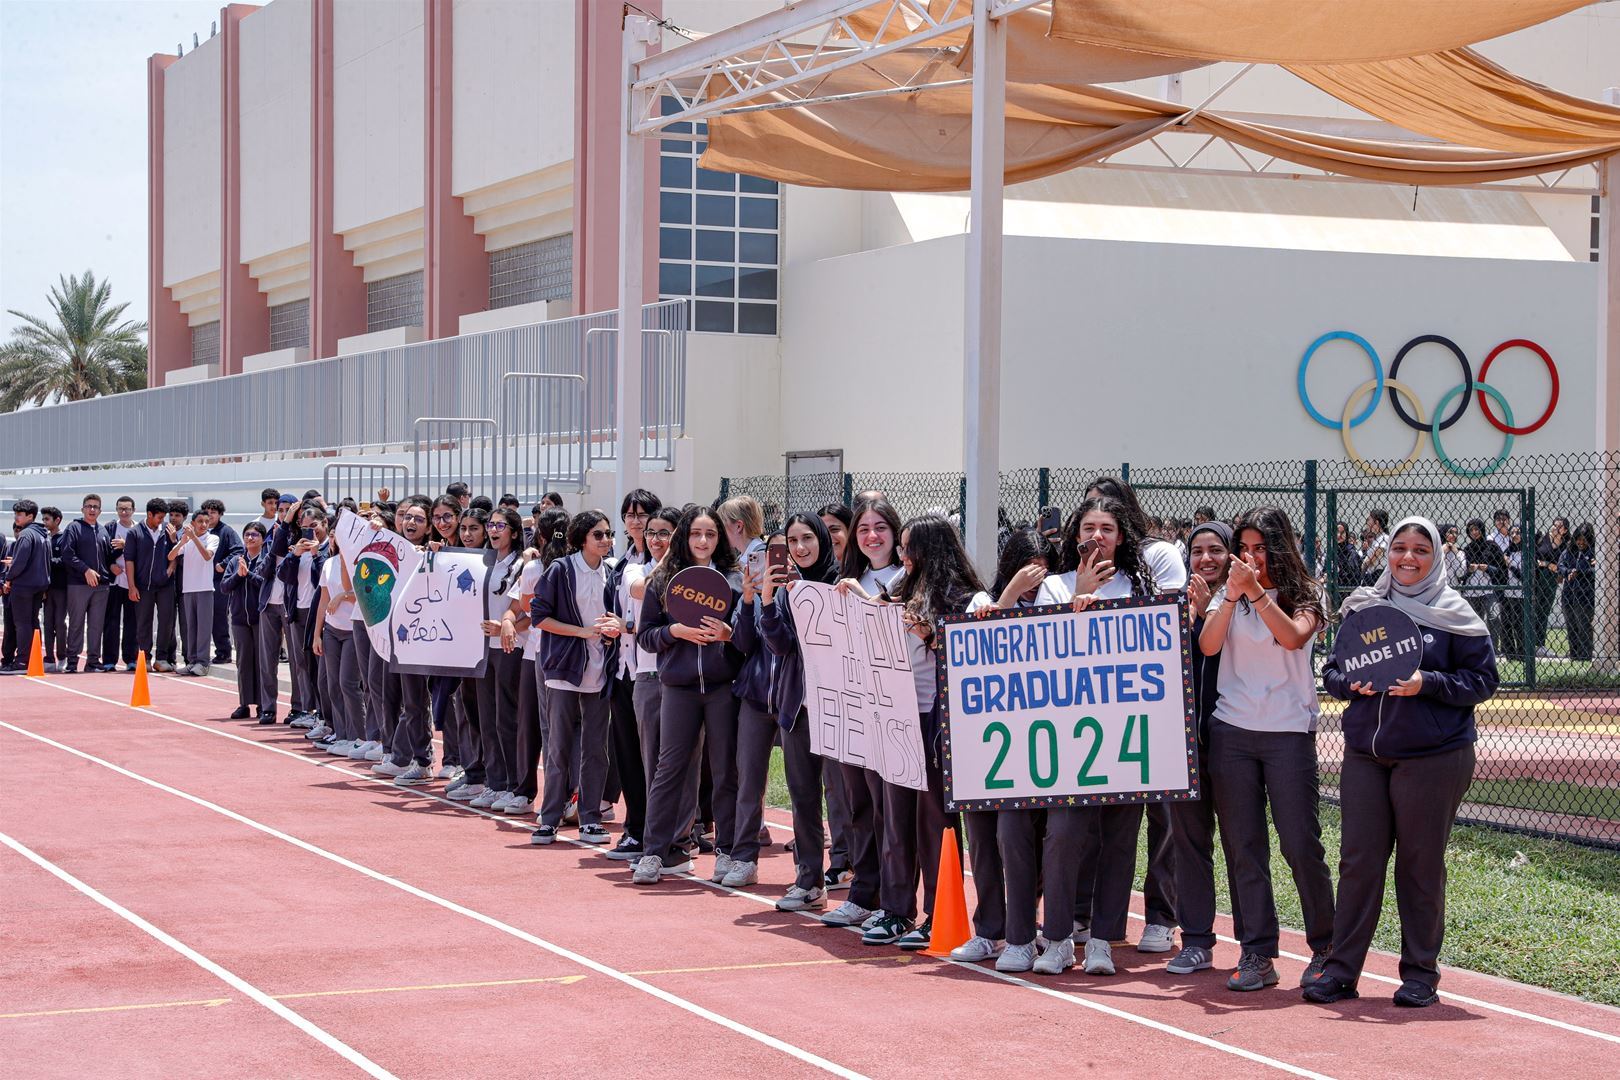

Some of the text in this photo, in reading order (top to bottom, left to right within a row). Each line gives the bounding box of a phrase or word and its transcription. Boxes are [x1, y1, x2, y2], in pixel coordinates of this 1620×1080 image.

[671, 584, 727, 612] #GRAD
[949, 611, 1173, 668] CONGRATULATIONS
[1344, 635, 1419, 673] MADE IT!
[1360, 626, 1388, 646] WE
[960, 662, 1166, 716] GRADUATES
[982, 713, 1151, 790] 2024
